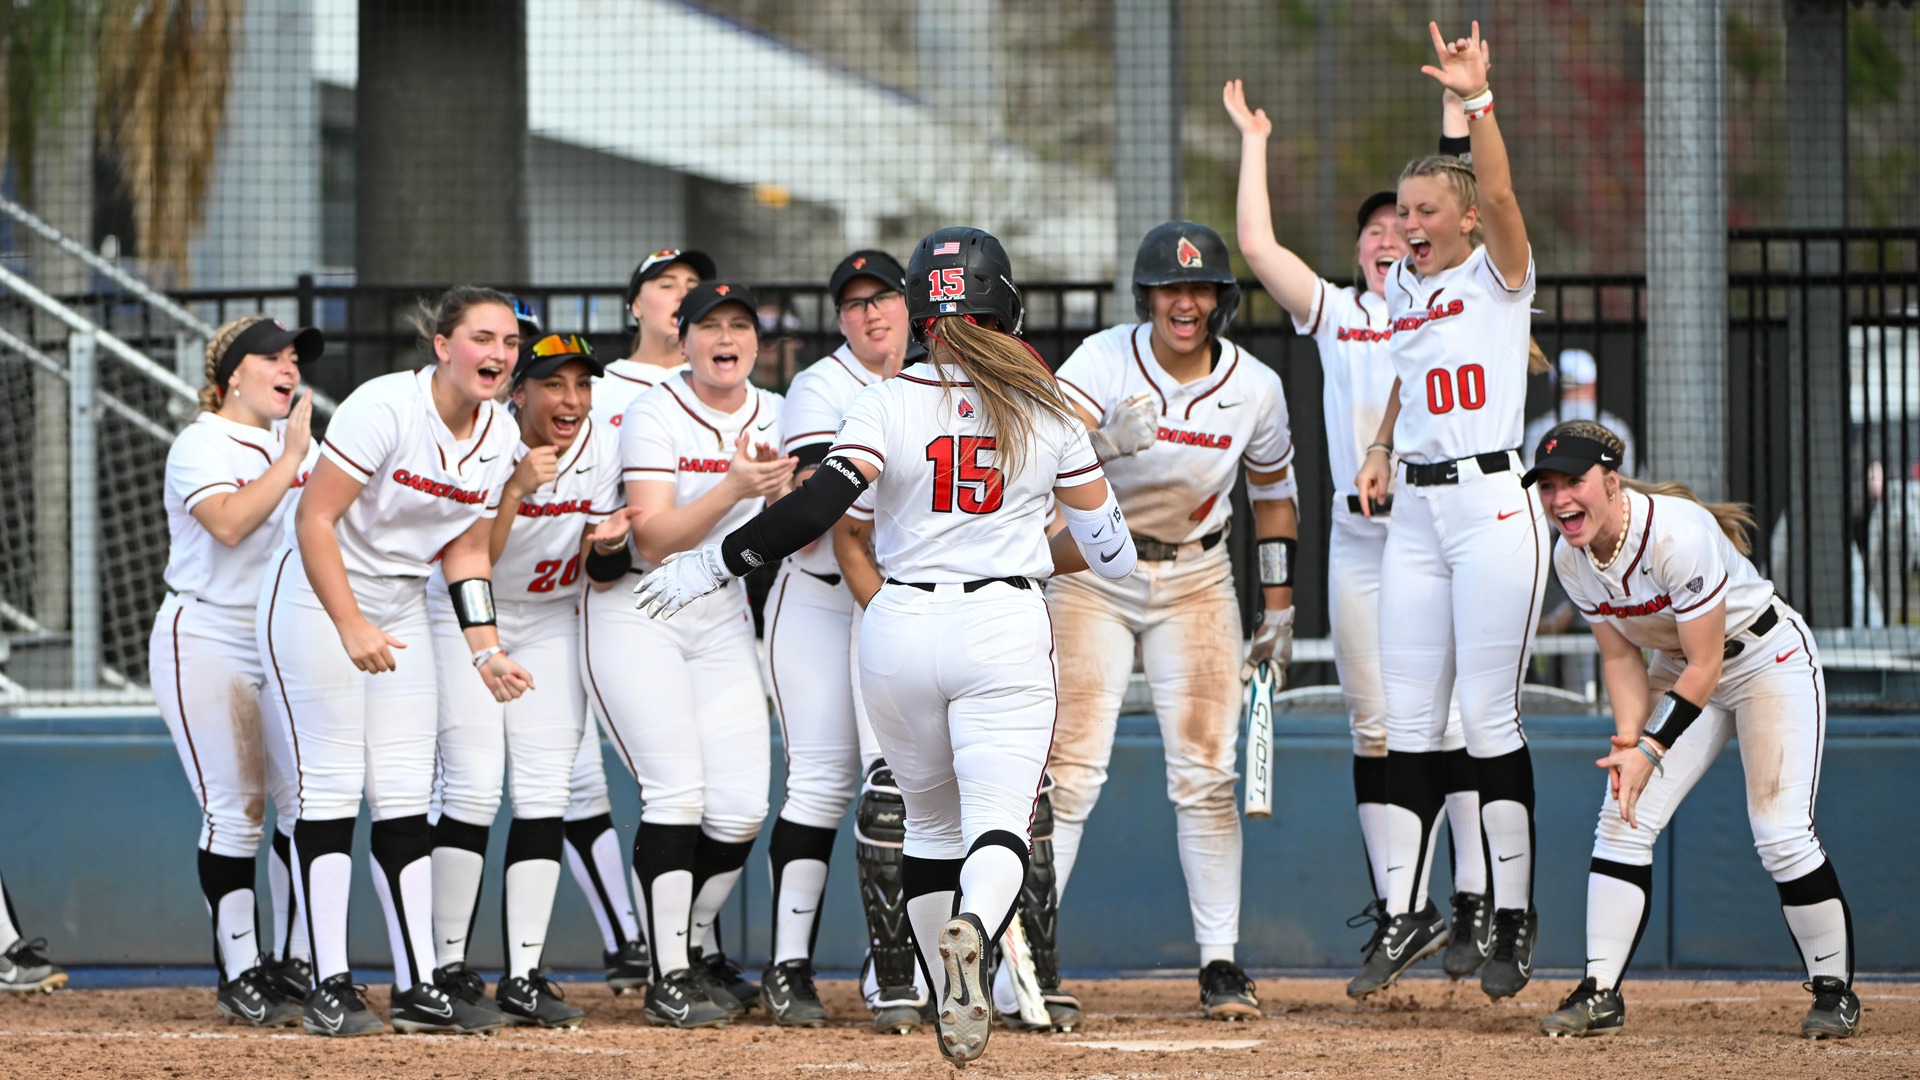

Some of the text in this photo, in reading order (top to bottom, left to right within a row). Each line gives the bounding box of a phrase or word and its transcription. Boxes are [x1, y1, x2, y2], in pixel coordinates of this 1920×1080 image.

[929, 267, 965, 297] 15
[1426, 363, 1486, 415] 00
[1156, 426, 1233, 450] DINALS
[925, 435, 1005, 515] 15
[1112, 506, 1122, 524] 15
[527, 553, 581, 593] 20
[1252, 702, 1269, 805] GHOST
